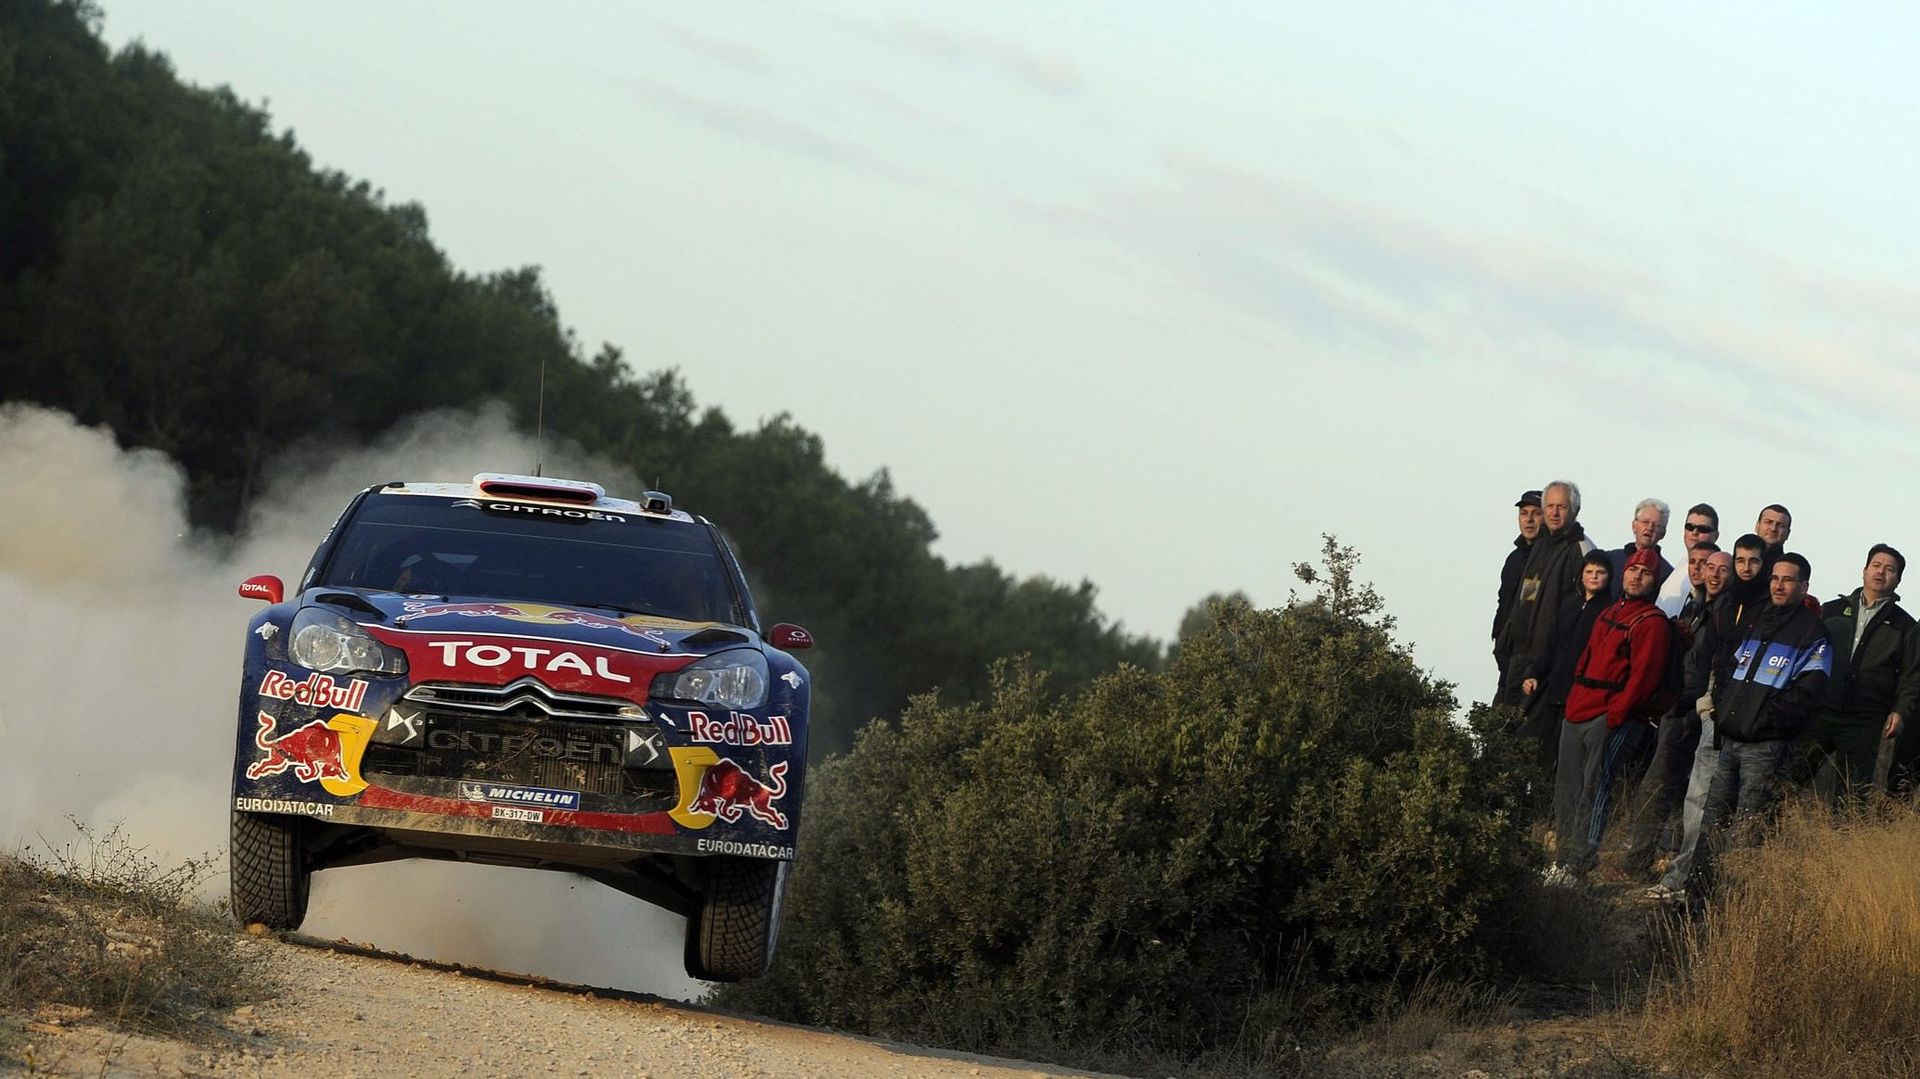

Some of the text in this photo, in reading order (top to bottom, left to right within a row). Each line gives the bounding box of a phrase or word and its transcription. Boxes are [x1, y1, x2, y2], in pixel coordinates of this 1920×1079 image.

[241, 583, 269, 592] TOTAL
[428, 641, 631, 683] TOTAL
[488, 788, 574, 805] MICHELIN
[236, 797, 334, 816] EURODATACAR
[494, 807, 541, 821] BK-317-DW
[697, 838, 793, 859] EURODATACAR
